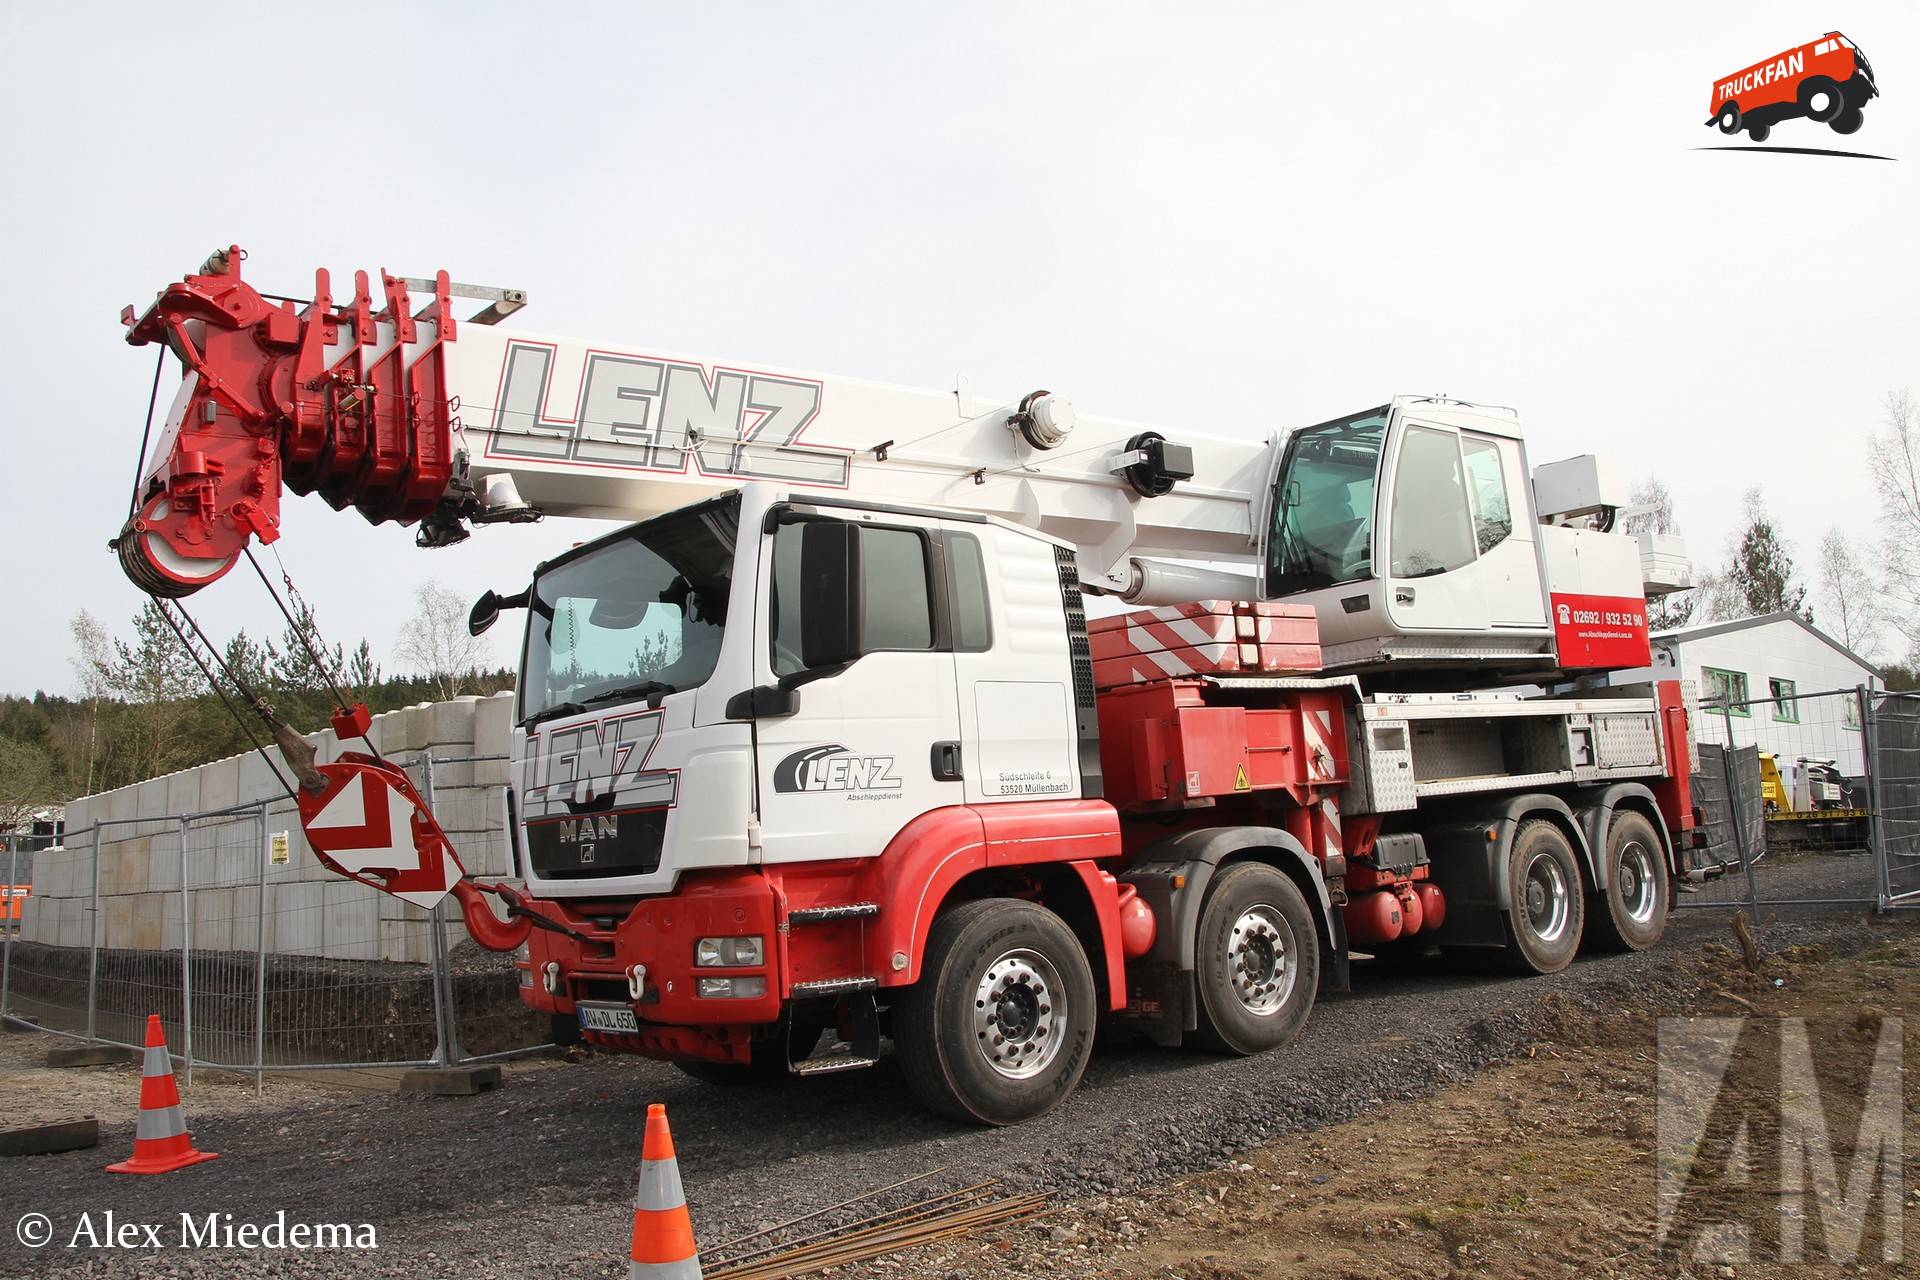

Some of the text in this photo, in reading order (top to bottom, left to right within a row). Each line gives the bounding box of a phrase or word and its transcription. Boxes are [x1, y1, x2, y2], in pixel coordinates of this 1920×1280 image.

[485, 339, 854, 489] LENZ
[1574, 611, 1600, 624] 02692
[1605, 612, 1621, 625] 932
[1622, 613, 1632, 626] 52
[1633, 614, 1643, 627] 90
[521, 707, 681, 826] LENZ
[805, 757, 902, 791] LENZ
[1046, 771, 1051, 780] 6
[847, 793, 903, 801] Abschleppdienst
[1000, 783, 1069, 794] 53520 Müllenbach
[559, 815, 618, 843] MAN
[584, 1009, 636, 1030] AW DL 650
